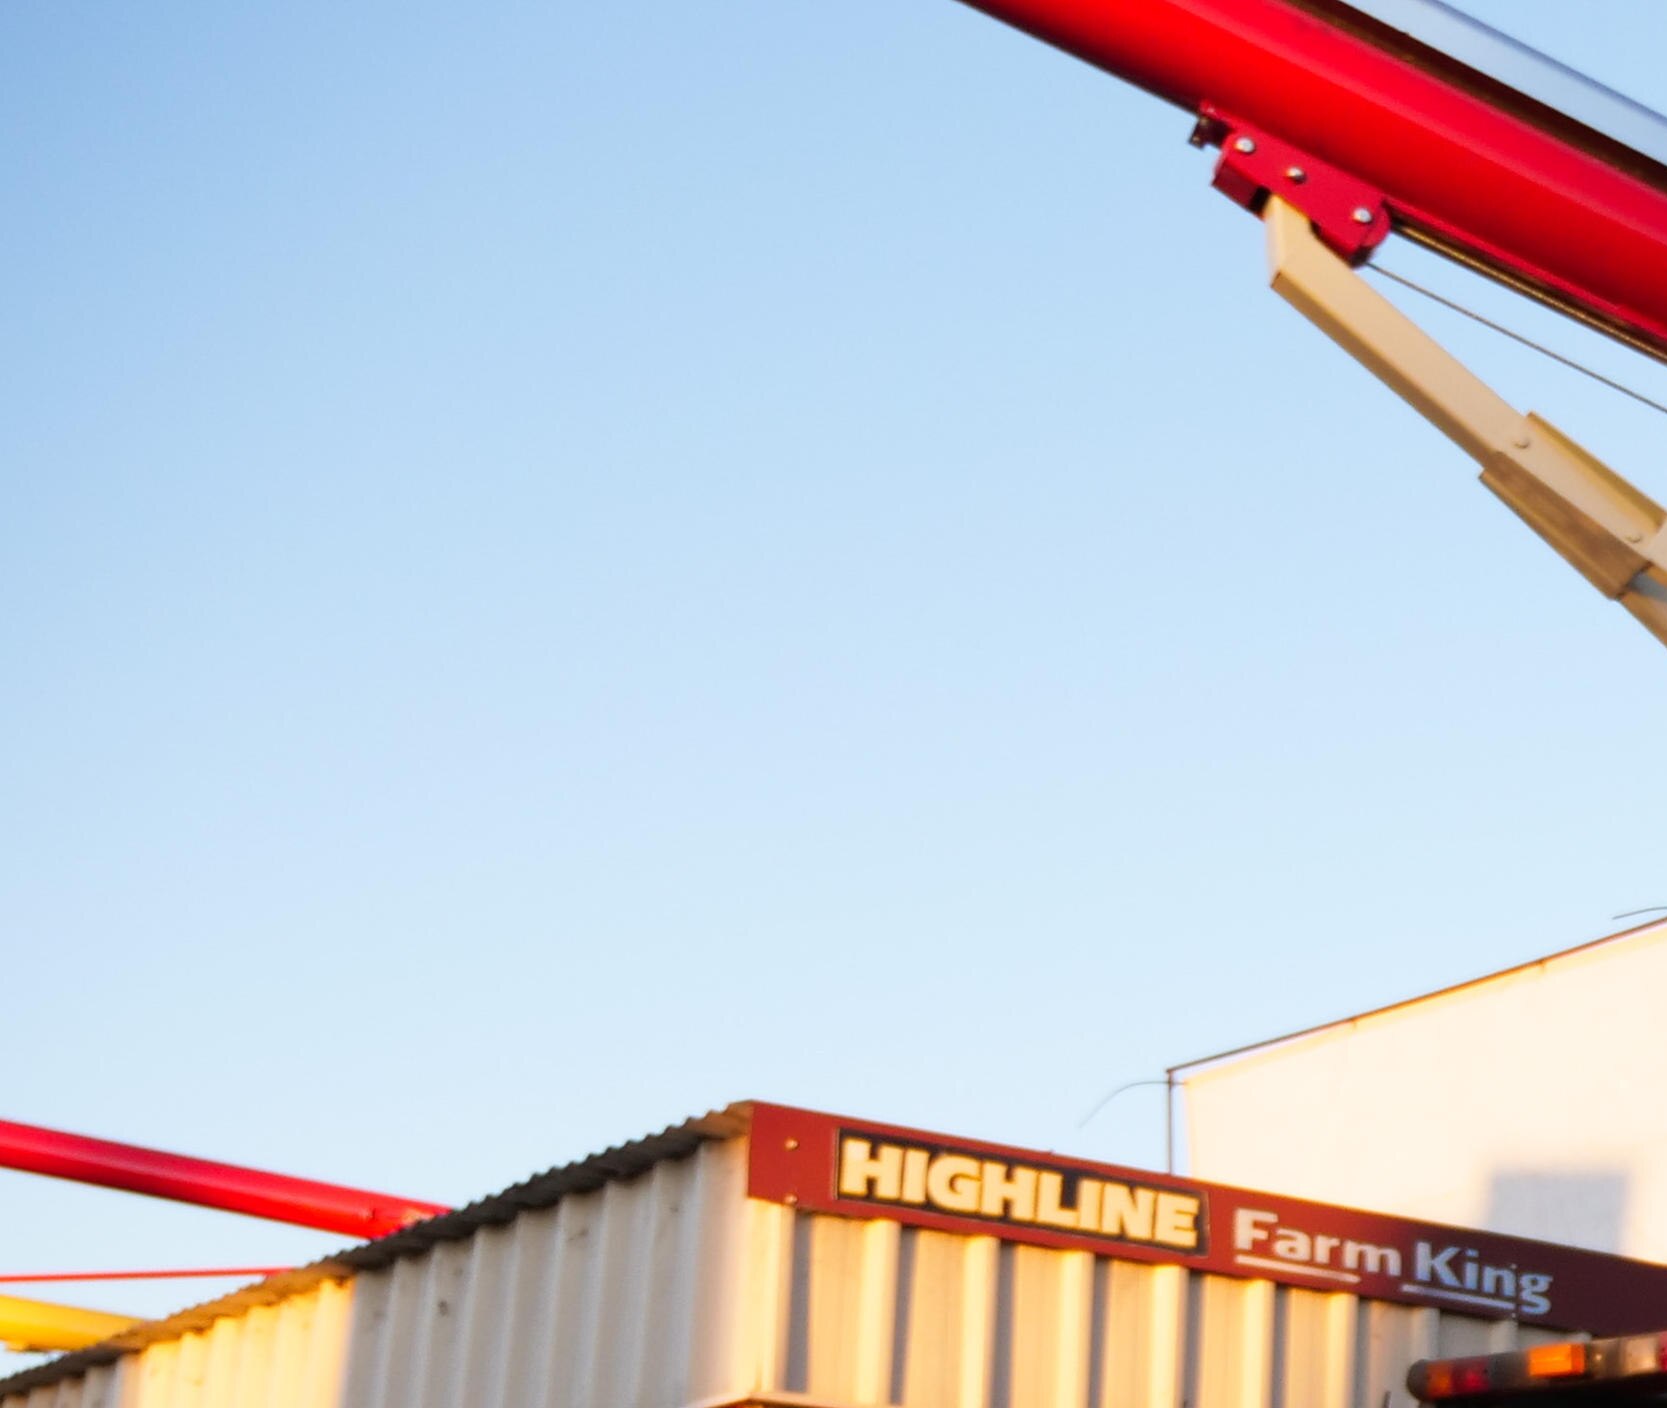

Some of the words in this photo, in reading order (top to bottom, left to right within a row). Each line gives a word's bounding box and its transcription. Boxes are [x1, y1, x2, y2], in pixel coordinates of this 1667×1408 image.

[838, 1137, 1200, 1250] HIGHLINE
[1234, 1208, 1400, 1278] Farm
[1414, 1240, 1552, 1316] King
